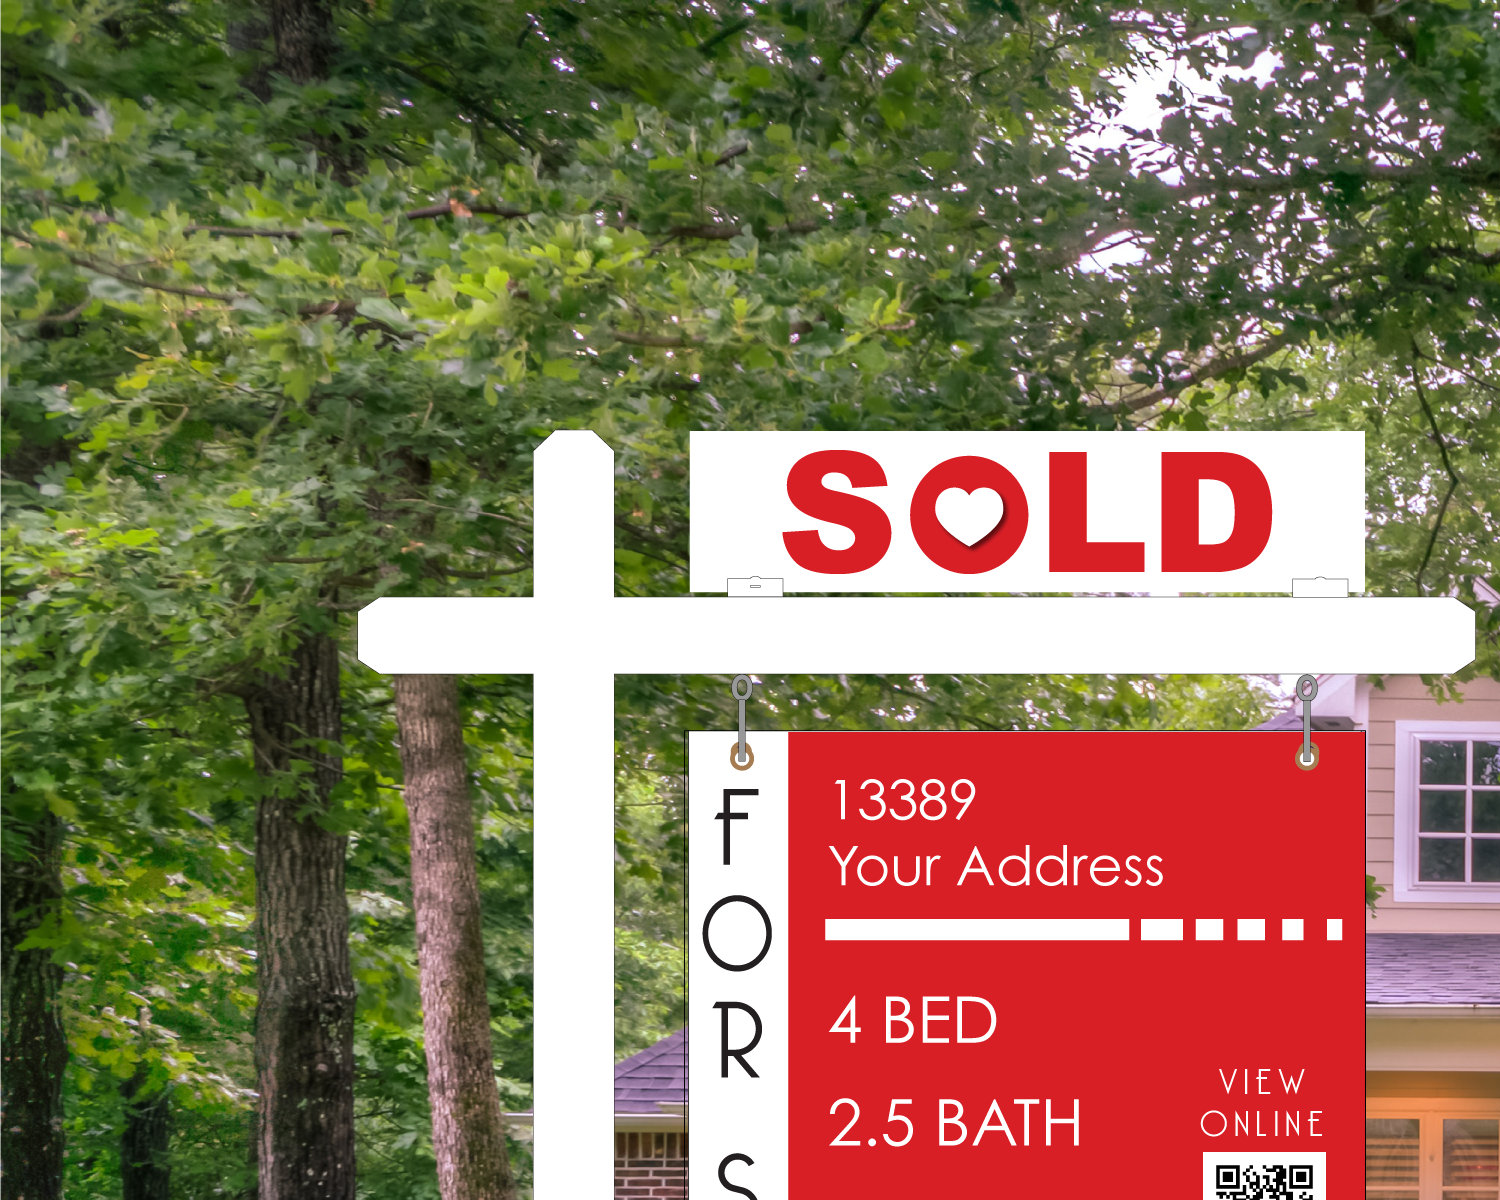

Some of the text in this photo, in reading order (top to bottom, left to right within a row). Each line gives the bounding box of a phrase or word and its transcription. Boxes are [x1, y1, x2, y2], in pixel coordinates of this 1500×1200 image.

[783, 450, 1272, 574] SOLD
[835, 779, 975, 820] 13389
[829, 845, 1163, 886] Your Address
[702, 789, 772, 1078] FOR
[829, 995, 996, 1043] 4 BED
[1219, 1069, 1304, 1094] VIEW
[830, 1098, 1079, 1147] 2.5 BATH
[1201, 1110, 1322, 1137] ONLINE
